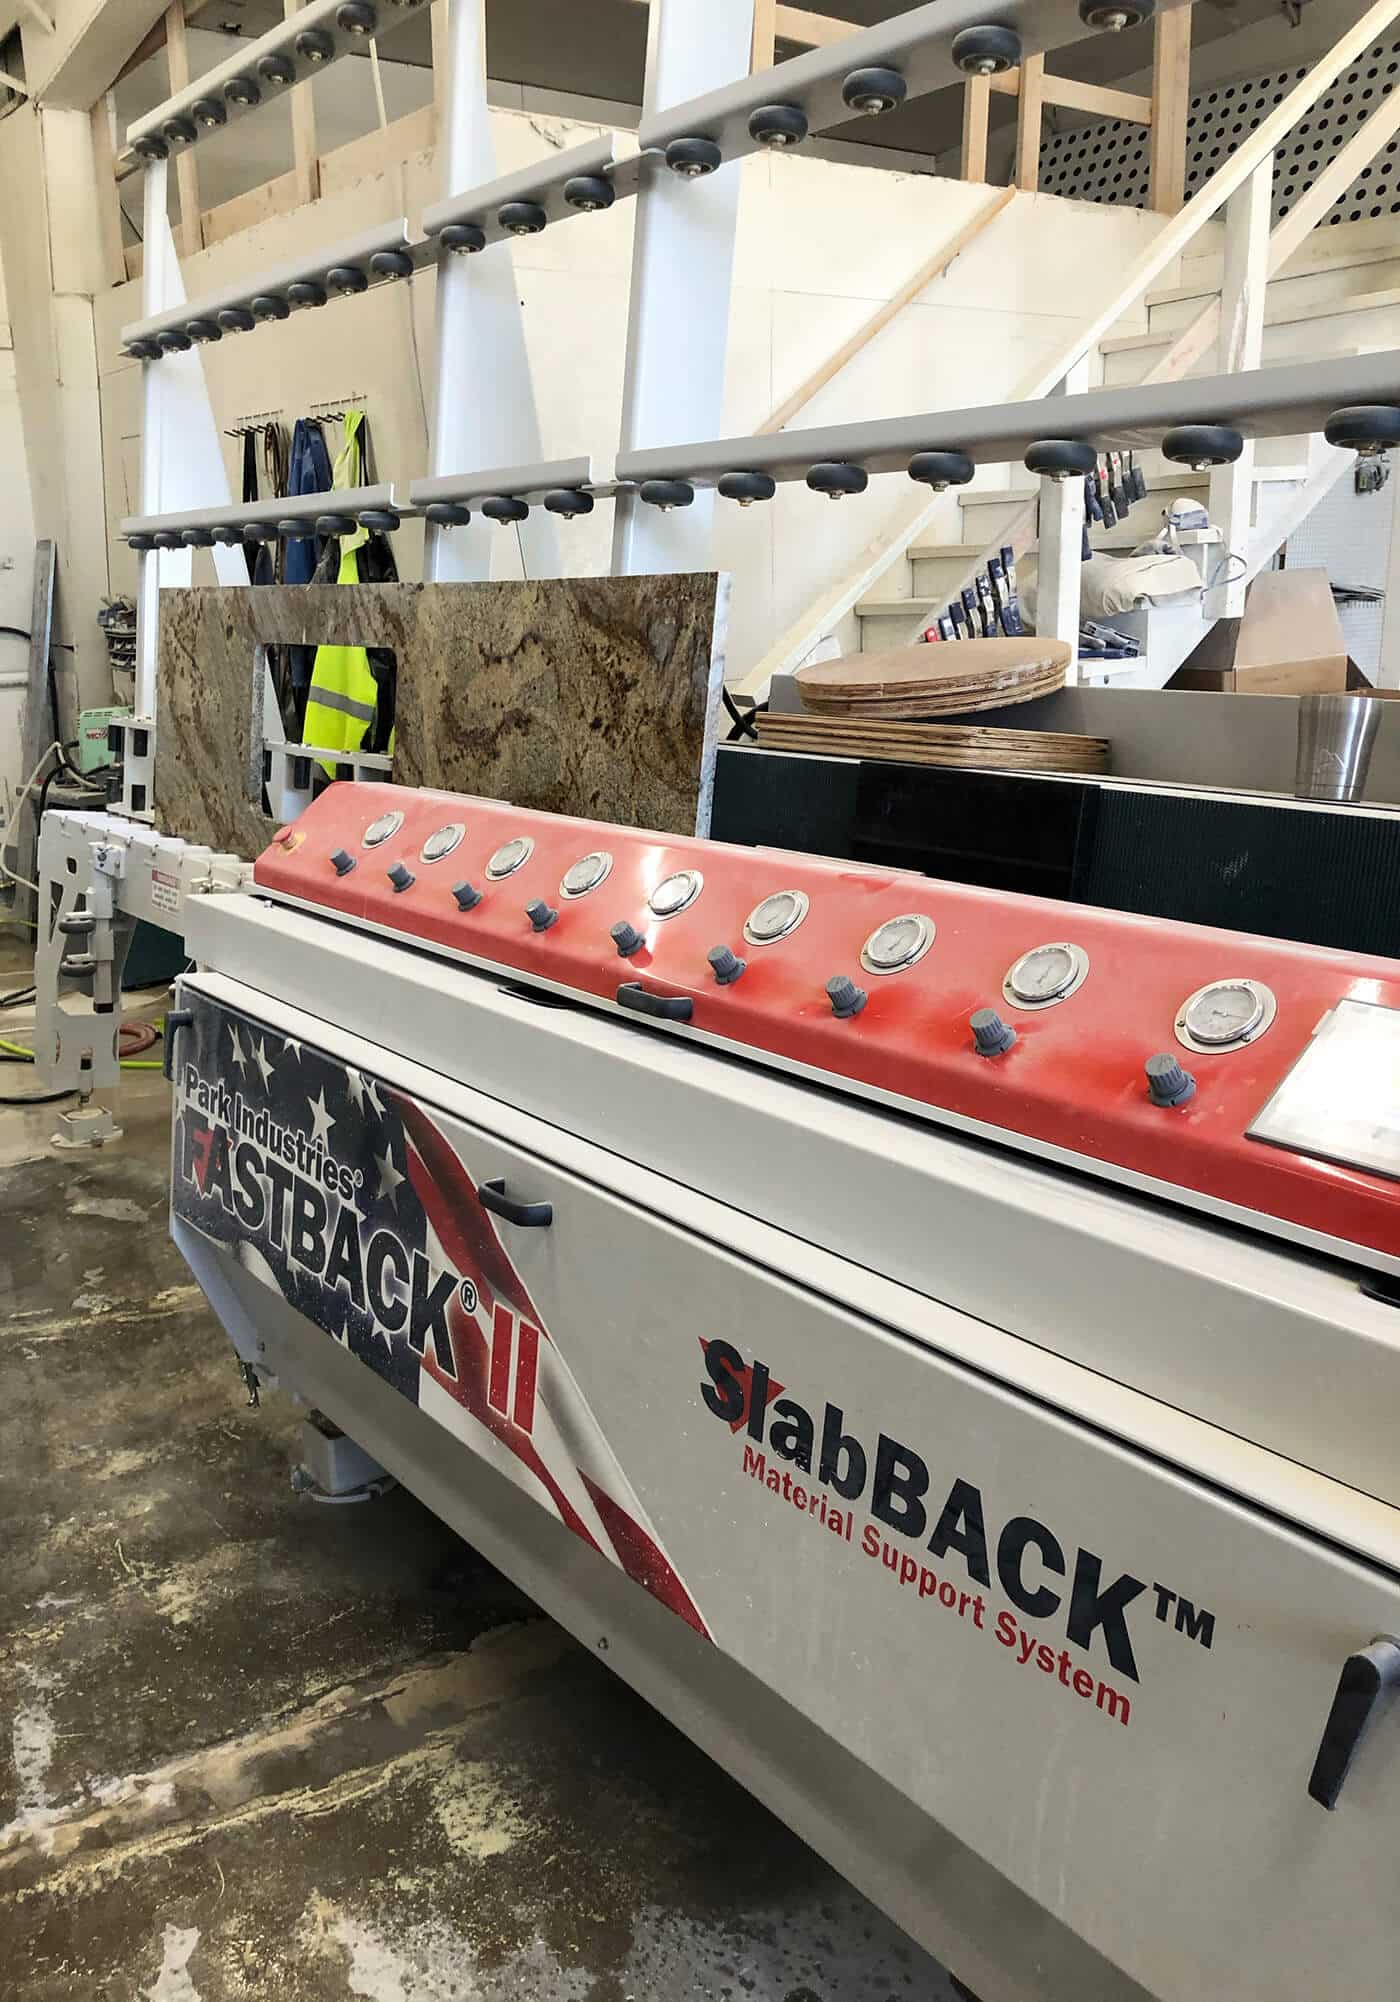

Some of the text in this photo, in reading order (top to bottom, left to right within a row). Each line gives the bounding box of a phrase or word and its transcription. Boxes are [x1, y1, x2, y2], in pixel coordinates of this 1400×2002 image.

[184, 1063, 232, 1127] Park
[742, 1445, 1132, 1727] Material Support System
